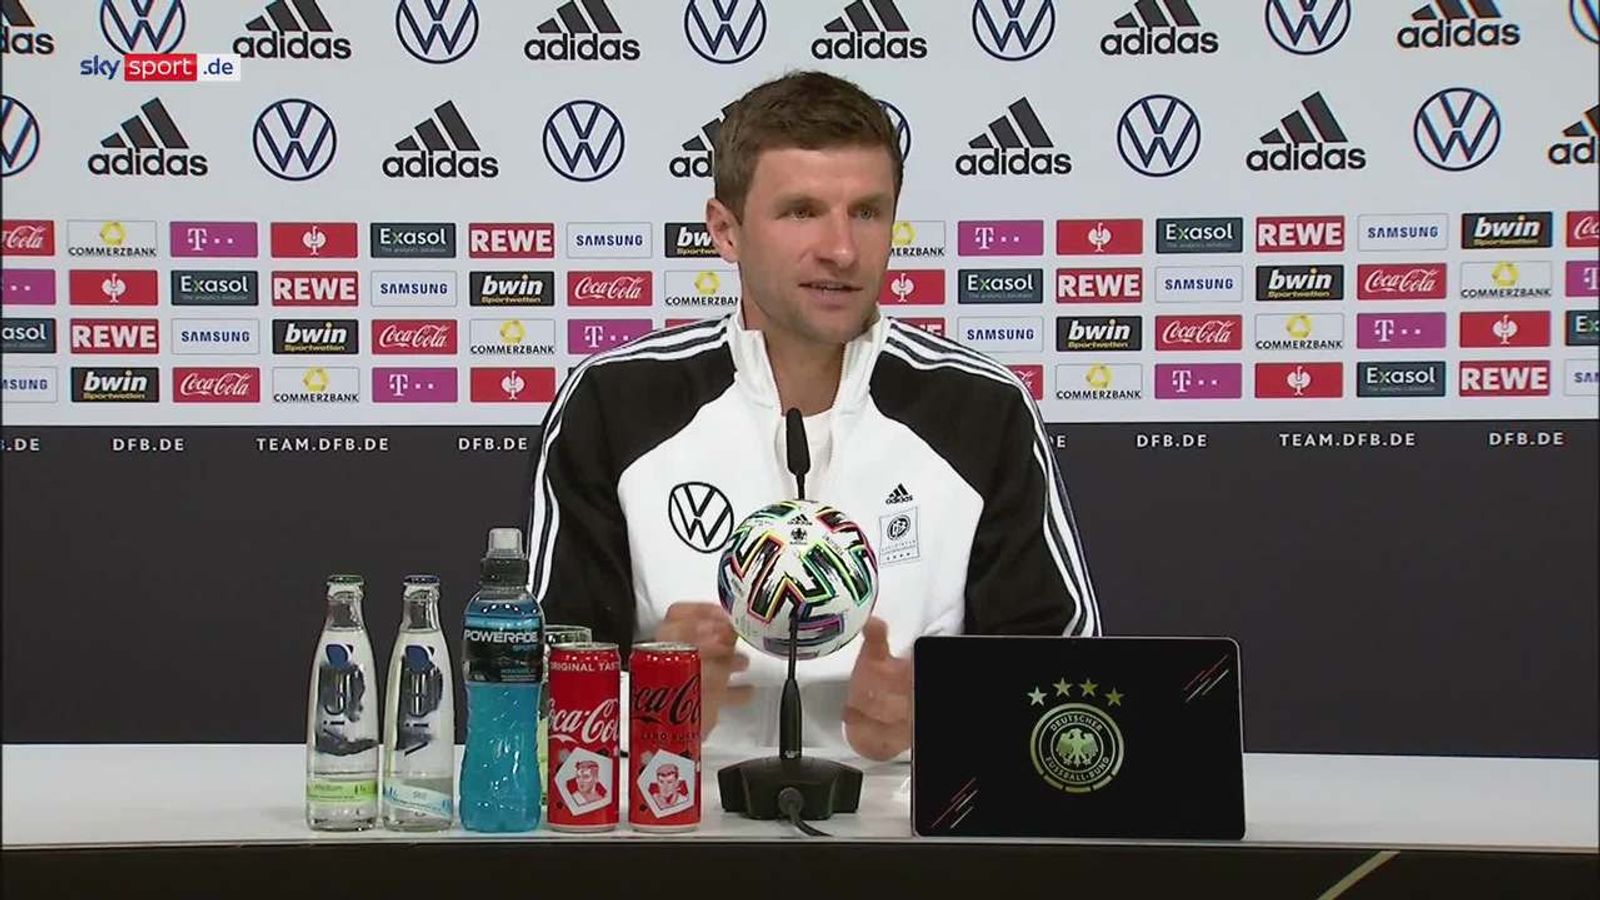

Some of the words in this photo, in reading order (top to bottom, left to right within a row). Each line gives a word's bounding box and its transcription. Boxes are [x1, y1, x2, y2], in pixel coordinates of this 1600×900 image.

[233, 31, 352, 59] adidas
[811, 32, 928, 59] adidas
[1100, 26, 1219, 55] adidas
[1397, 22, 1521, 48] adidas
[524, 33, 641, 61] adidas
[87, 147, 208, 177] adidas
[382, 150, 500, 179] adidas
[955, 147, 1073, 176] adidas
[1246, 143, 1367, 171] adidas
[380, 228, 446, 245] Exasol
[677, 226, 713, 247] bw
[1166, 223, 1232, 239] Exasol
[1258, 222, 1343, 246] REWE
[1368, 226, 1439, 238] SAMSUNG
[1474, 215, 1541, 238] bwin
[471, 230, 552, 253] REWE
[576, 234, 643, 246] SAMSUNG
[68, 247, 156, 256] COMMERZBANK
[891, 247, 945, 256] ERZBANK
[181, 276, 248, 292] Exasol
[273, 278, 356, 300] REWE
[380, 282, 447, 294] SAMSUNG
[481, 274, 543, 296] bwin
[574, 276, 643, 300] Coca-Cola
[968, 274, 1033, 290] Exasol
[1058, 274, 1141, 298] REWE
[1164, 278, 1233, 290] SAMSUNG
[1268, 267, 1332, 290] bwin
[1365, 269, 1440, 293] Coca-Cola
[1461, 287, 1551, 298] COMMERZBANK
[2, 324, 46, 340] asol
[73, 325, 157, 348] REWE
[181, 331, 250, 343] SAMSUNG
[284, 322, 347, 344] bwin
[379, 324, 447, 348] Coca-Cola
[967, 328, 1034, 340] SAMSUNG
[1068, 319, 1131, 340] bwin
[1162, 320, 1235, 344] Coca-Cola
[471, 345, 554, 355] COMMERZBANK
[1256, 340, 1343, 349] COMMERZBANK
[84, 370, 148, 393] bwin
[180, 372, 250, 396] Coca-Cola
[1366, 366, 1435, 384] Exasol
[1461, 367, 1548, 391] REWE
[274, 393, 359, 403] COMMERZBANK
[1057, 390, 1142, 400] COMMERZBANK
[113, 438, 184, 451] DFB.DE
[257, 438, 389, 451] TEAM.DFB.DE
[459, 437, 528, 450] DFB.DE
[1137, 434, 1208, 448] DFB.DE
[1280, 433, 1416, 447] TEAM.DFB.DE
[1489, 432, 1565, 446] DFB.DE
